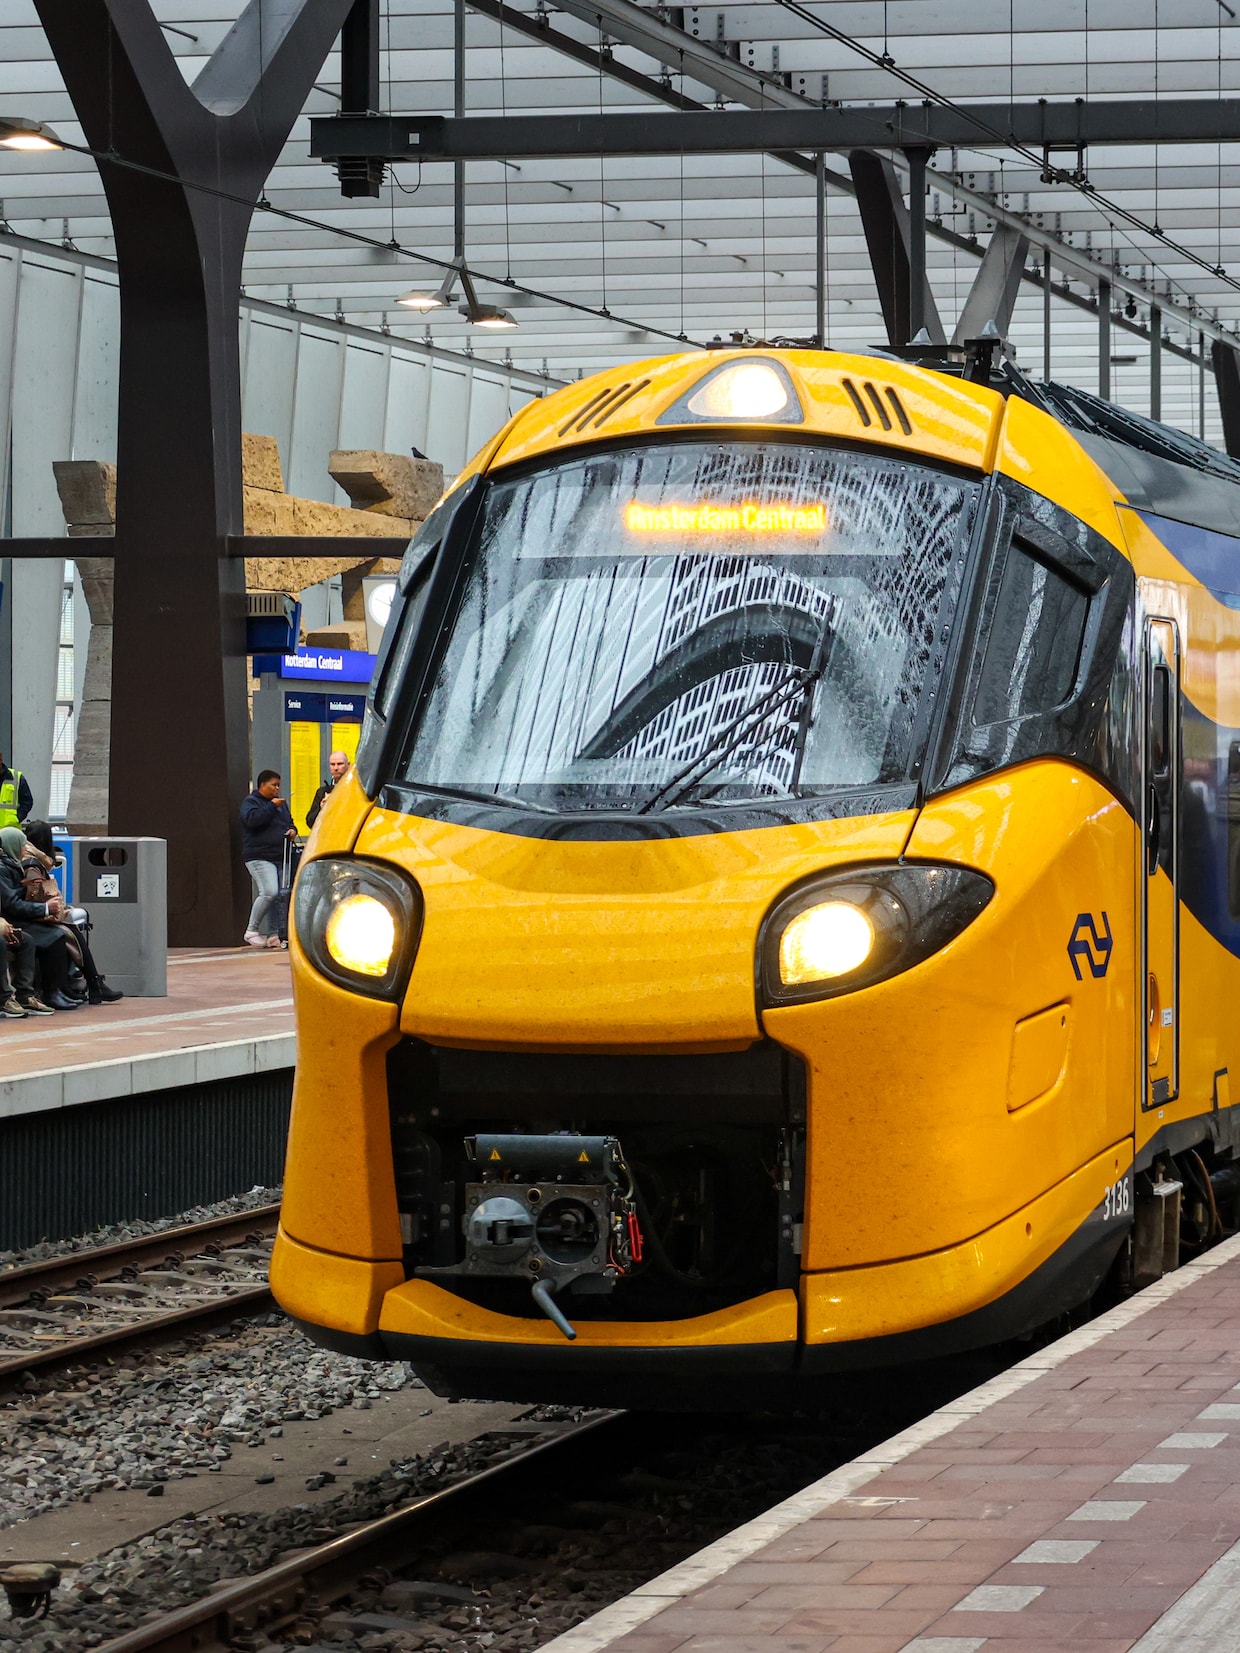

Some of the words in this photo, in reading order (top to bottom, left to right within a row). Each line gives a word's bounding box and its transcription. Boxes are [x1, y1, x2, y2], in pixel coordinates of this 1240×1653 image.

[627, 505, 738, 530] Amsterdam
[741, 505, 825, 530] Centraal
[285, 653, 317, 669] Rotterdam
[318, 655, 343, 670] Centraal
[288, 700, 302, 709] Service
[1103, 1177, 1129, 1221] 3136
